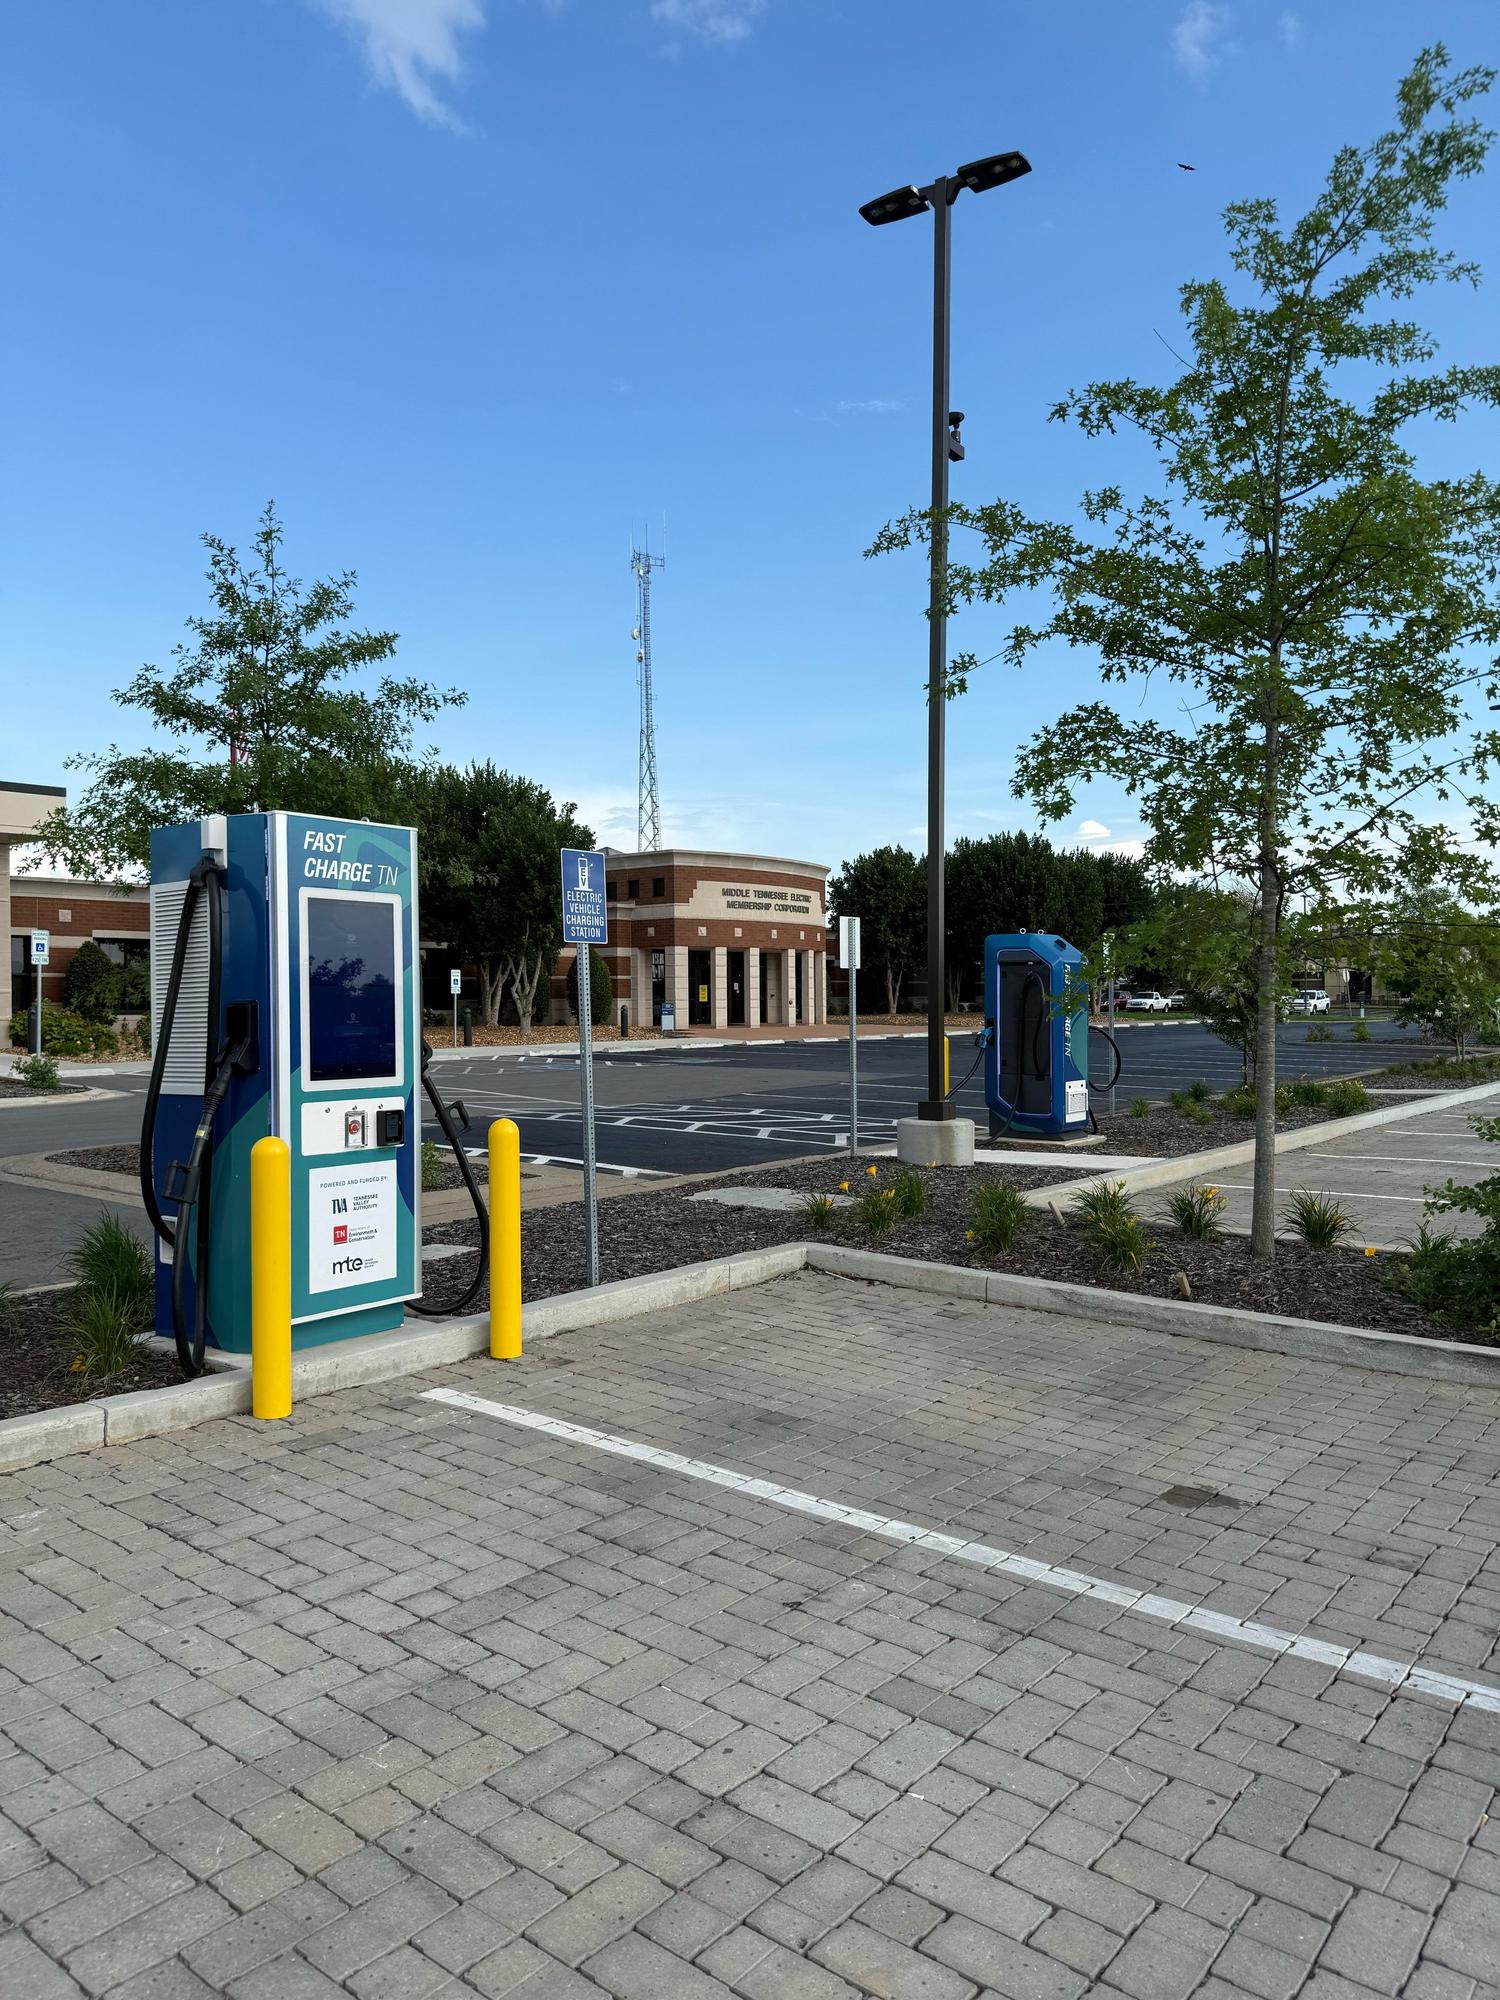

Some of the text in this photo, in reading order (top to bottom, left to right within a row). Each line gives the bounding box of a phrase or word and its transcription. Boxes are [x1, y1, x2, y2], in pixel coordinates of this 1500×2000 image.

[304, 831, 346, 853] FAST
[304, 857, 398, 886] CHARGE TN
[567, 891, 602, 903] ELECTRIC
[722, 888, 812, 903] MIDDLE TENNESSEE ELECTRIC
[569, 903, 600, 914] VEHICLE
[726, 901, 810, 914] MEMBERSHIP CORPORATION
[566, 914, 604, 927] CHARGING
[571, 926, 600, 938] STATION
[319, 1181, 346, 1189] POWERED
[331, 1198, 348, 1214] TVA
[335, 1230, 345, 1239] TN
[349, 1229, 374, 1237] Environment
[332, 1256, 363, 1274] mte
